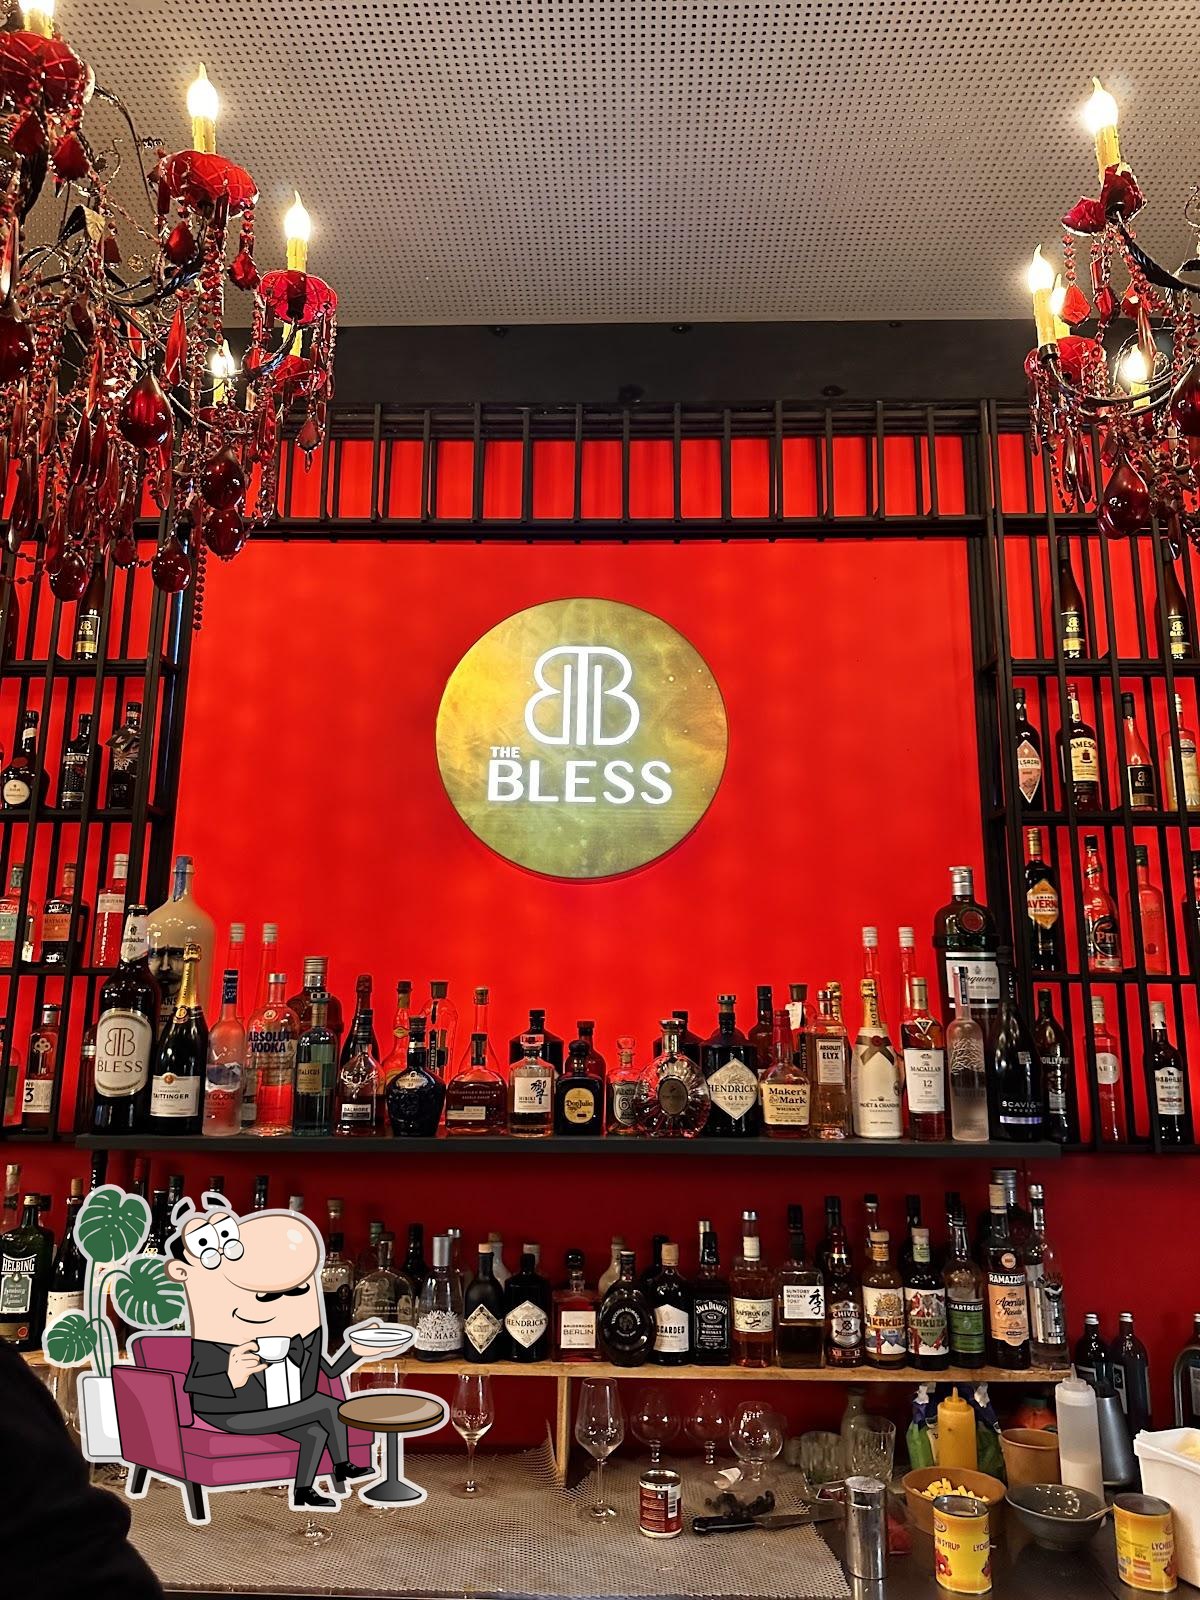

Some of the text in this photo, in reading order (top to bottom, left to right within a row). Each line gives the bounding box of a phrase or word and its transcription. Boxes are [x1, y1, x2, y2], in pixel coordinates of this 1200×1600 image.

[490, 746, 520, 758] THE
[487, 759, 673, 805] BLESS
[248, 1031, 291, 1042] ABSOLUT
[251, 1042, 286, 1053] VODKA
[822, 1052, 840, 1060] ELYX
[97, 1060, 143, 1073] BLESS
[923, 1080, 933, 1088] 12
[24, 1088, 34, 1103] 3
[769, 1087, 807, 1096] Maker's
[779, 1096, 807, 1104] Mark
[2, 1257, 35, 1272] HELBING
[696, 1303, 709, 1314] JACK
[942, 1539, 961, 1551] SYRUP
